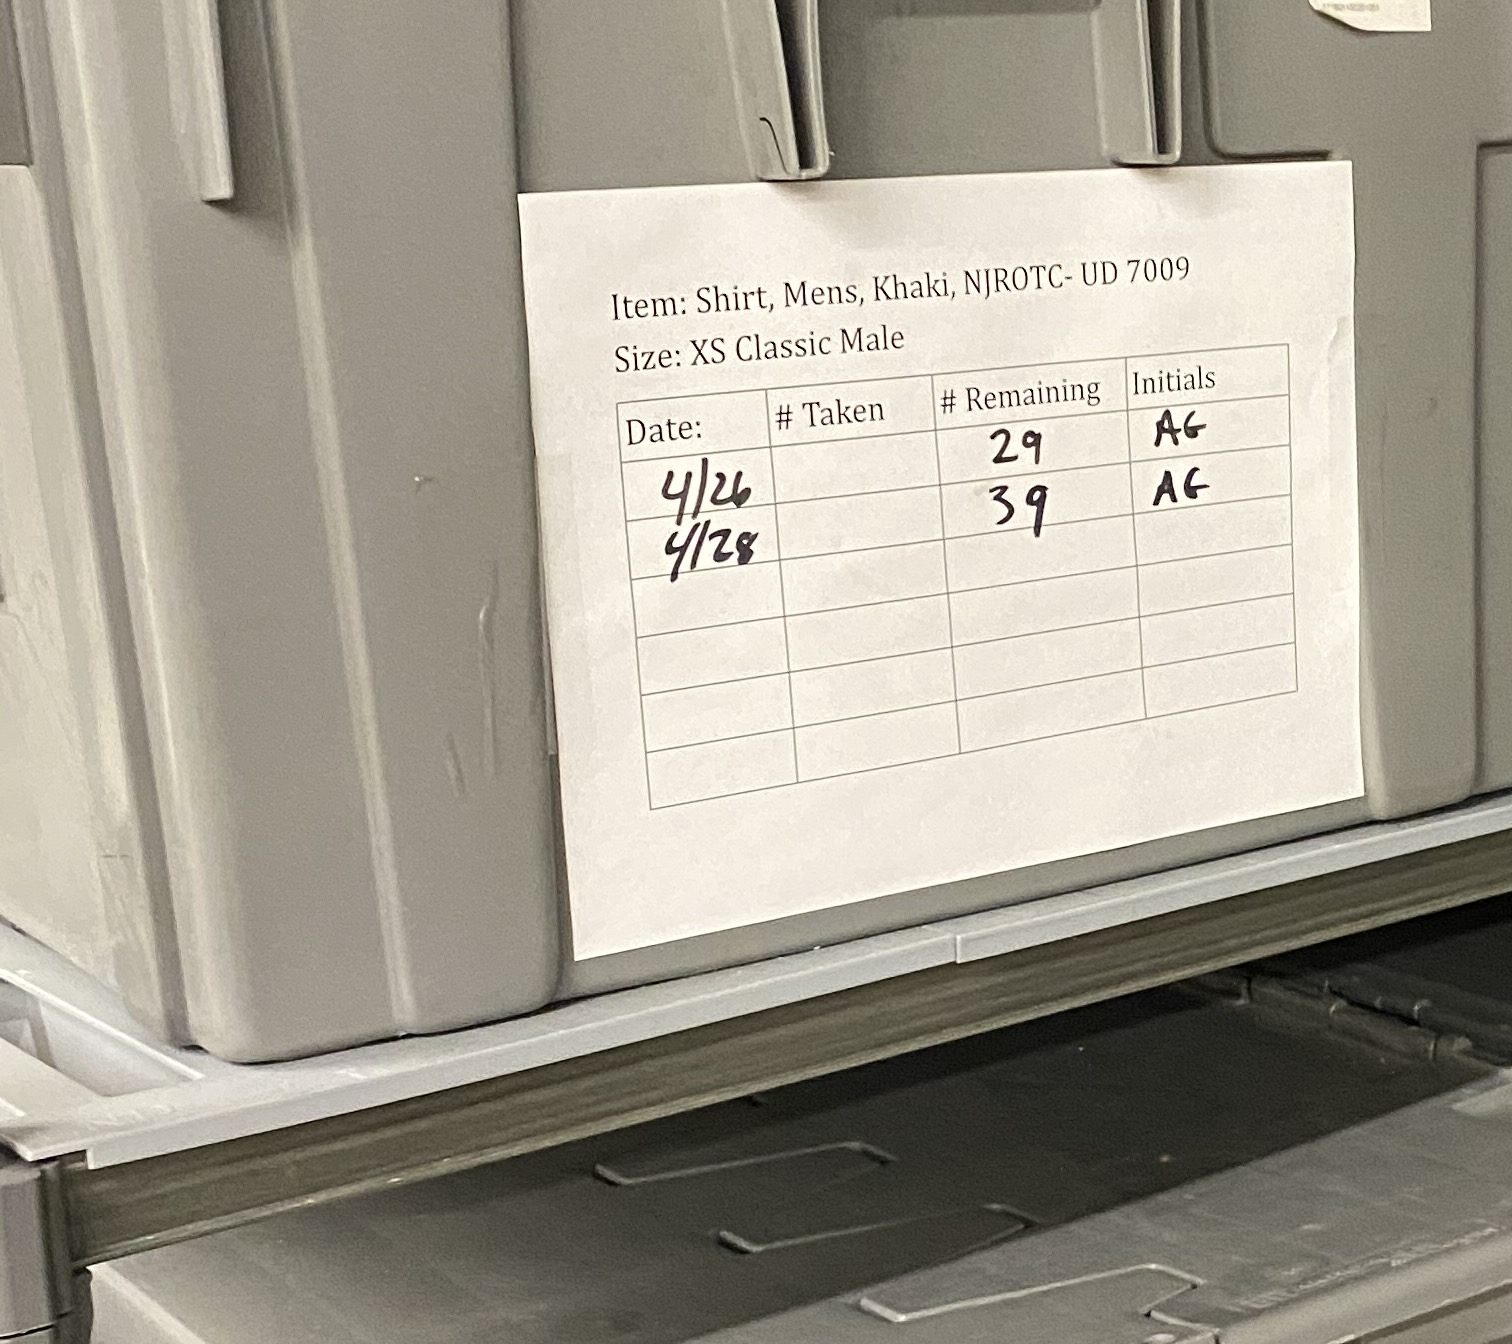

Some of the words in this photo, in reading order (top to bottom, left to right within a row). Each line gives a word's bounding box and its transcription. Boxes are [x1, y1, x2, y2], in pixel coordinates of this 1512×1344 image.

[611, 292, 688, 323] Item:
[695, 284, 776, 318] Shirt,
[783, 277, 866, 310] Mens,
[872, 268, 957, 303] Khaki,
[963, 262, 1074, 300] NJROTC-
[1080, 260, 1119, 288] UD
[1126, 256, 1192, 285] 7009
[614, 343, 682, 374] Size:
[689, 338, 728, 367] XS
[735, 329, 832, 365] Classic
[839, 326, 905, 355] Male
[940, 391, 958, 415] #
[965, 378, 1101, 413] Remaining
[1132, 367, 1217, 397] Initials
[625, 415, 703, 446] Date:
[775, 406, 793, 429] #
[800, 398, 886, 425] Taken
[1154, 409, 1207, 447] AG
[990, 428, 1043, 466] 29
[661, 457, 753, 526] 4/26
[988, 484, 1049, 538] 39
[664, 517, 759, 583] 4/28
